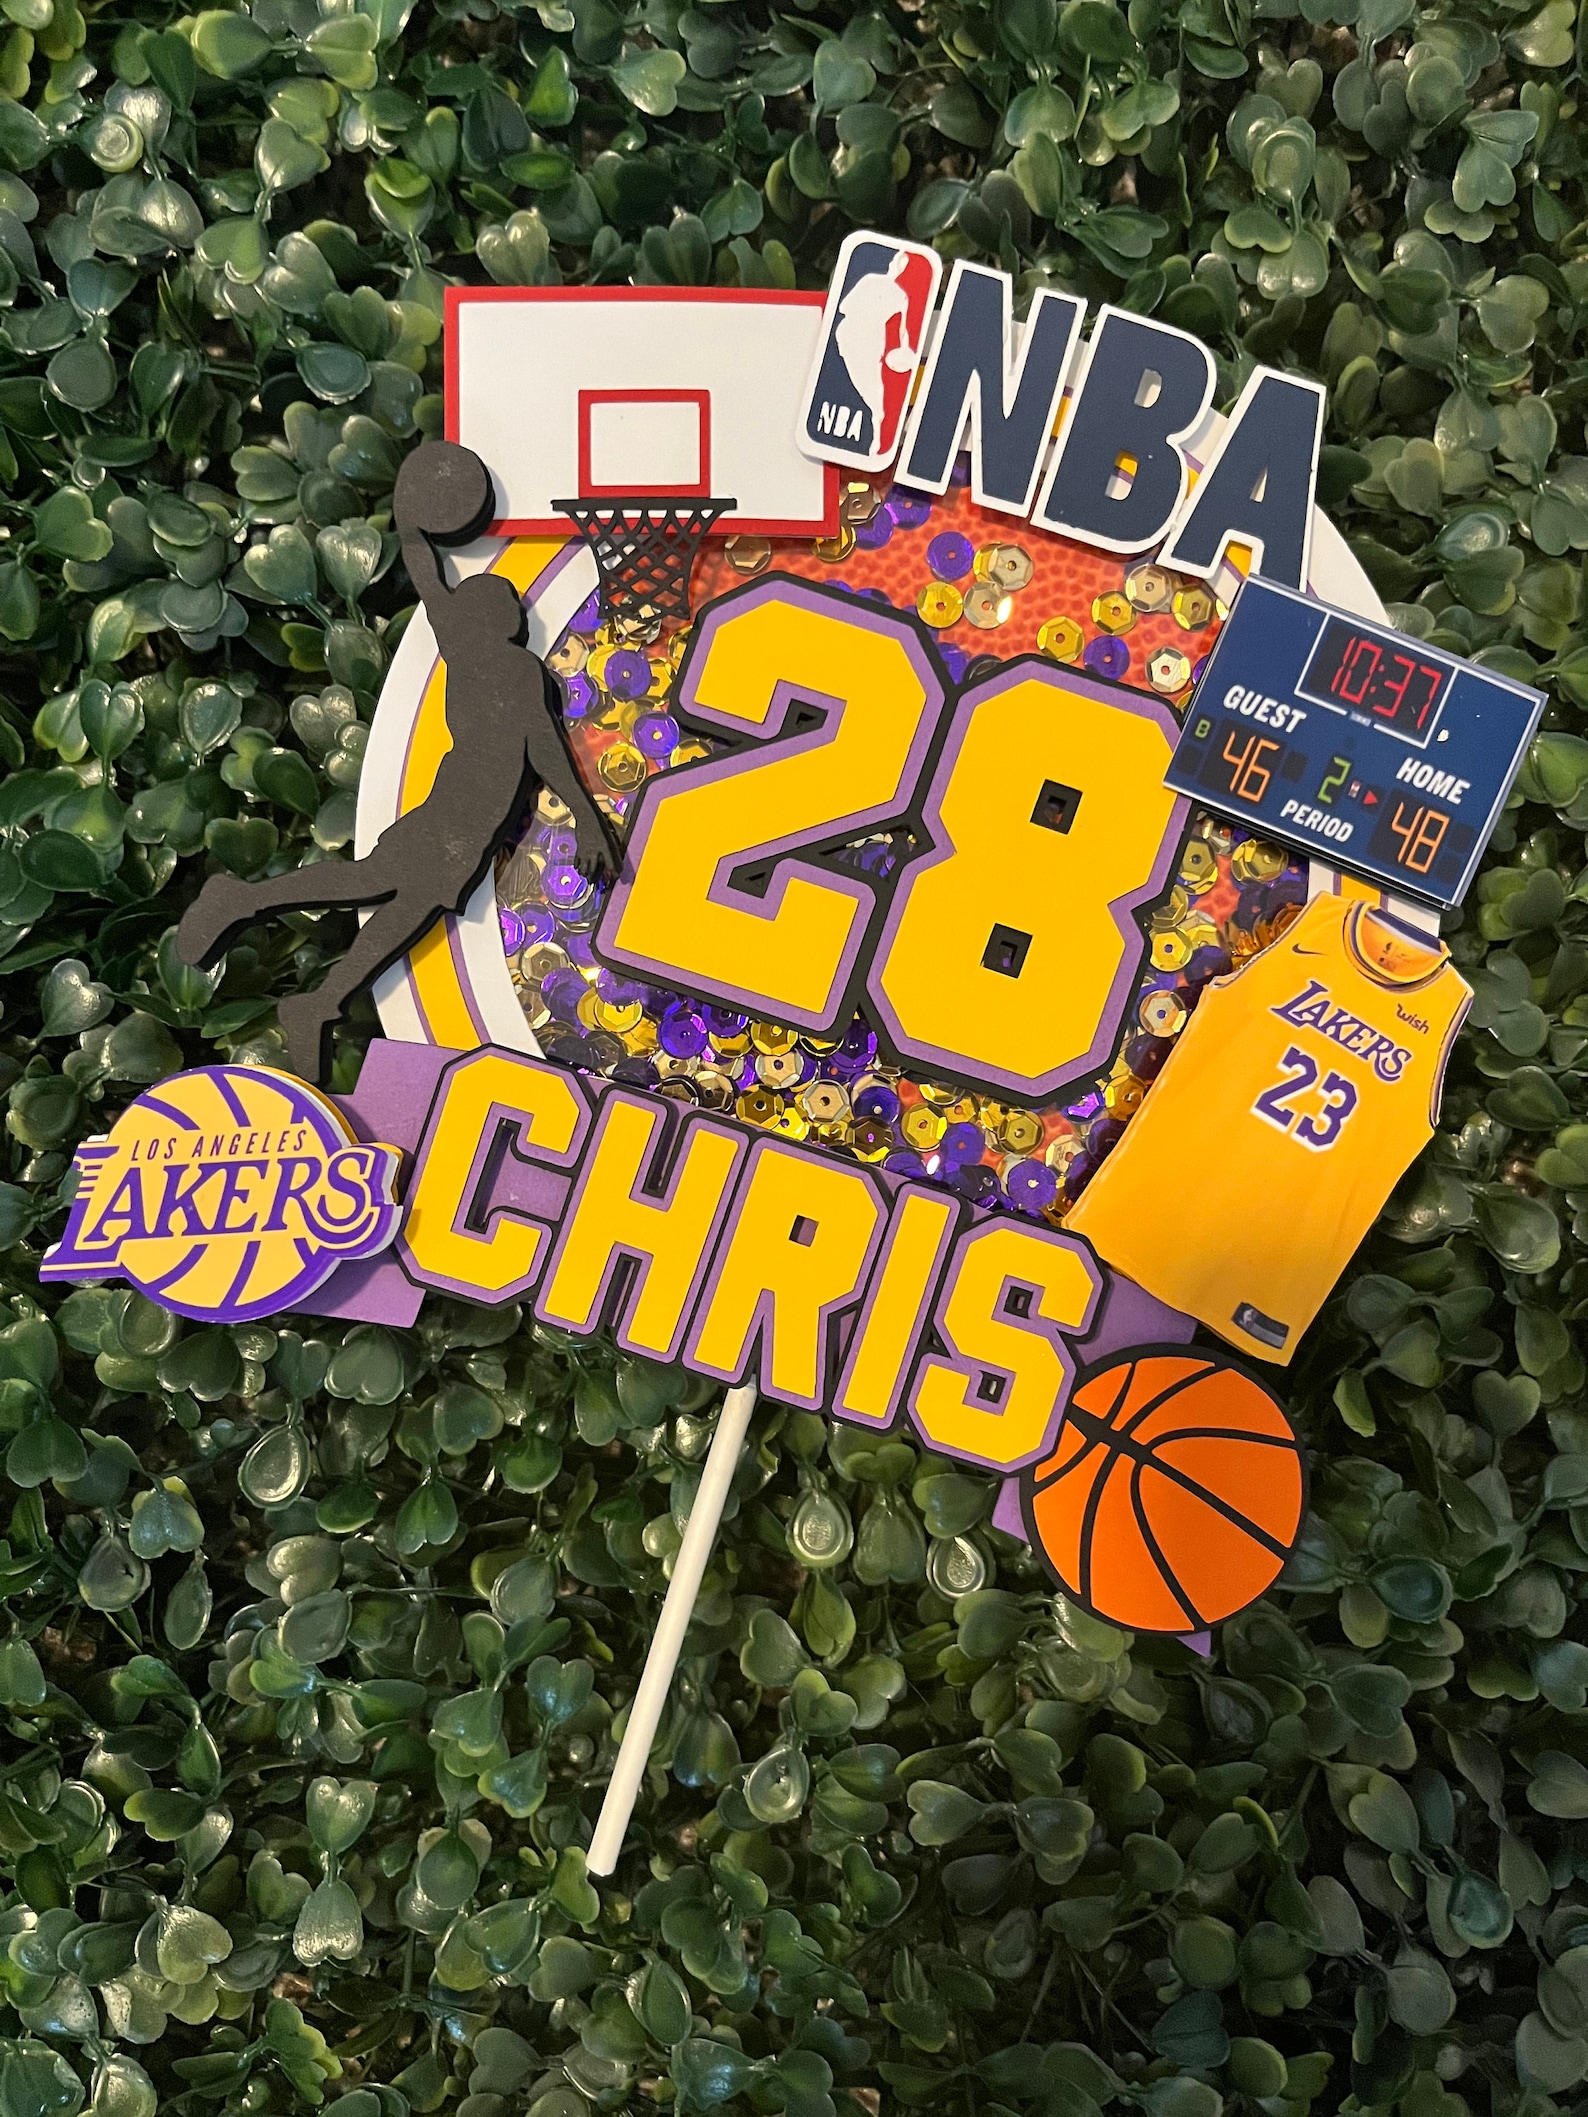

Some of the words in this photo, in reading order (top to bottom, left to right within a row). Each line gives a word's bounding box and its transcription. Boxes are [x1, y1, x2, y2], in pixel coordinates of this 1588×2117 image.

[817, 401, 863, 441] NBA
[895, 260, 1326, 594] NBA
[1222, 684, 1307, 734] GUEST
[1331, 636, 1443, 730] 10:37
[1222, 730, 1281, 803] 46
[1317, 756, 1352, 804] 2
[1396, 756, 1471, 805] HOME
[601, 578, 1190, 1092] 28
[1280, 799, 1355, 844] PERIOD
[1390, 801, 1451, 874] 48
[1269, 978, 1413, 1083] LAKERS
[1395, 1003, 1429, 1035] wish
[1250, 1044, 1360, 1153] 23
[130, 1138, 178, 1162] LOS
[191, 1129, 308, 1159] ANGELES
[40, 1145, 379, 1265] LAKERS
[396, 1046, 1101, 1472] CHRIS
